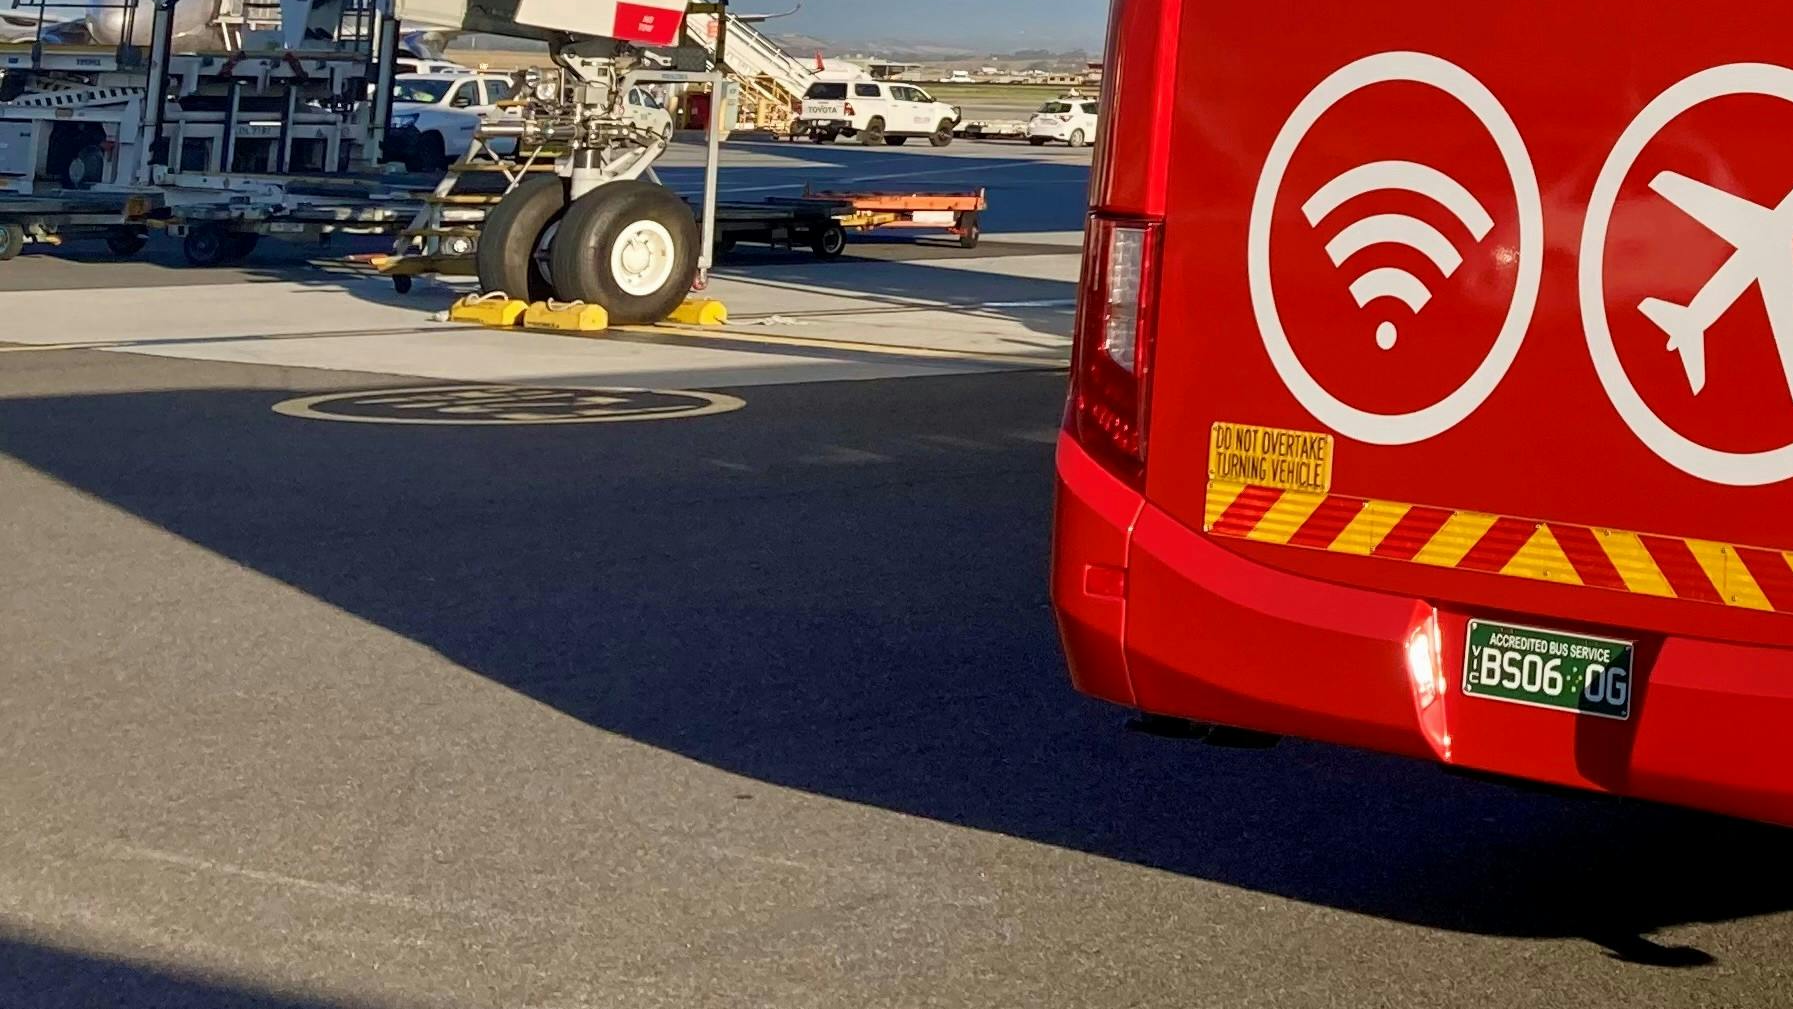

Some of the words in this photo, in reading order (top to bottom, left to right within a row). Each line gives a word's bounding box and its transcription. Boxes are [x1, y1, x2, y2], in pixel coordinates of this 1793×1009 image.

[808, 106, 838, 114] TOYOTA
[1216, 425, 1233, 450] DO
[1236, 428, 1259, 452] NOT
[1262, 431, 1325, 461] OVERTAKE
[1216, 452, 1267, 481] TURNING
[1271, 458, 1322, 488] VEHICLE
[1469, 645, 1482, 684] VIC
[1489, 633, 1548, 654] ACCREDITED
[1549, 641, 1569, 657] BUS
[1569, 644, 1611, 663] SERVICE
